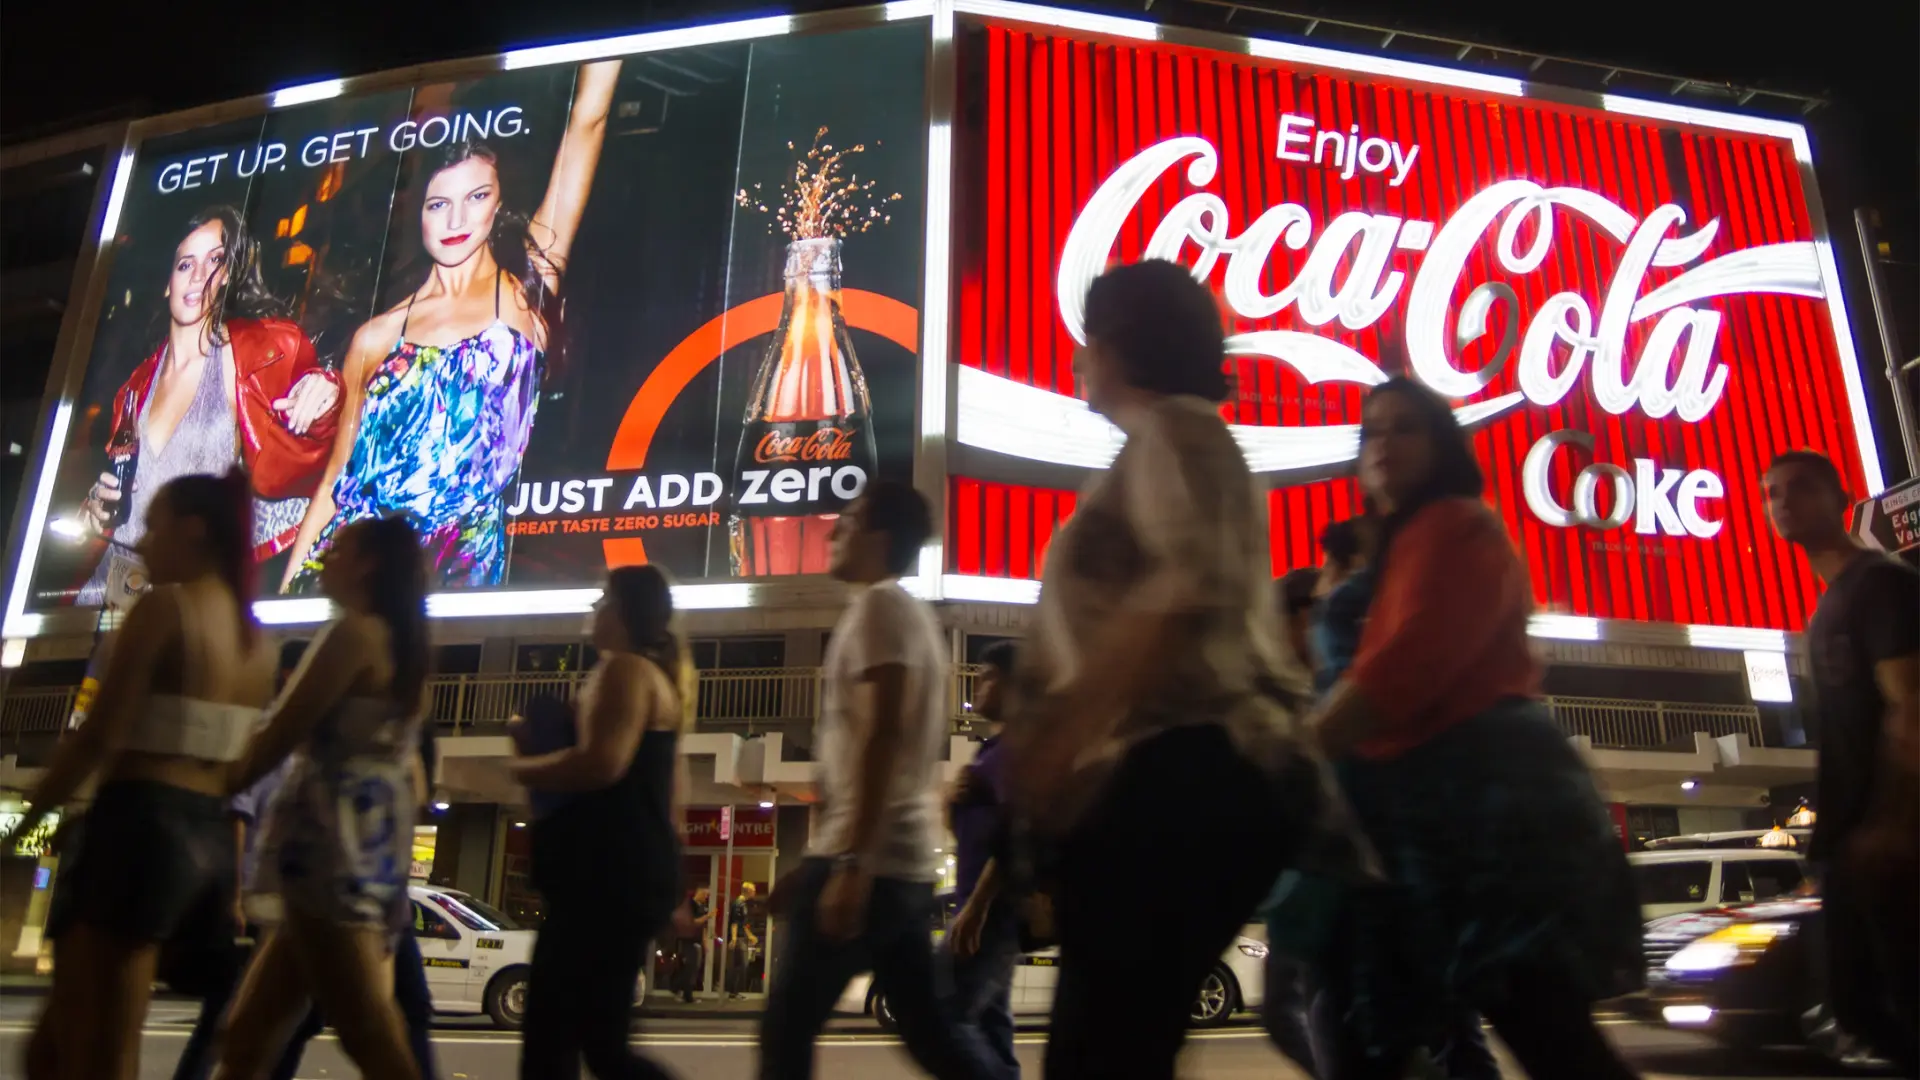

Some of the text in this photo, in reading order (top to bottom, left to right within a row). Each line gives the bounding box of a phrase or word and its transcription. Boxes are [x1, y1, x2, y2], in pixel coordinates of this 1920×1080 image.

[157, 105, 531, 195] GET UP. GET GOING.
[1276, 113, 1421, 187] Enjoy
[1057, 136, 1730, 423] Coca-Cola
[754, 427, 856, 463] Coca-Cola
[506, 465, 868, 516] JUST ADD zero
[1522, 428, 1725, 540] Coke
[506, 511, 721, 536] GREAT TASTE ZERO SUGAR
[1892, 509, 1920, 528] Edg
